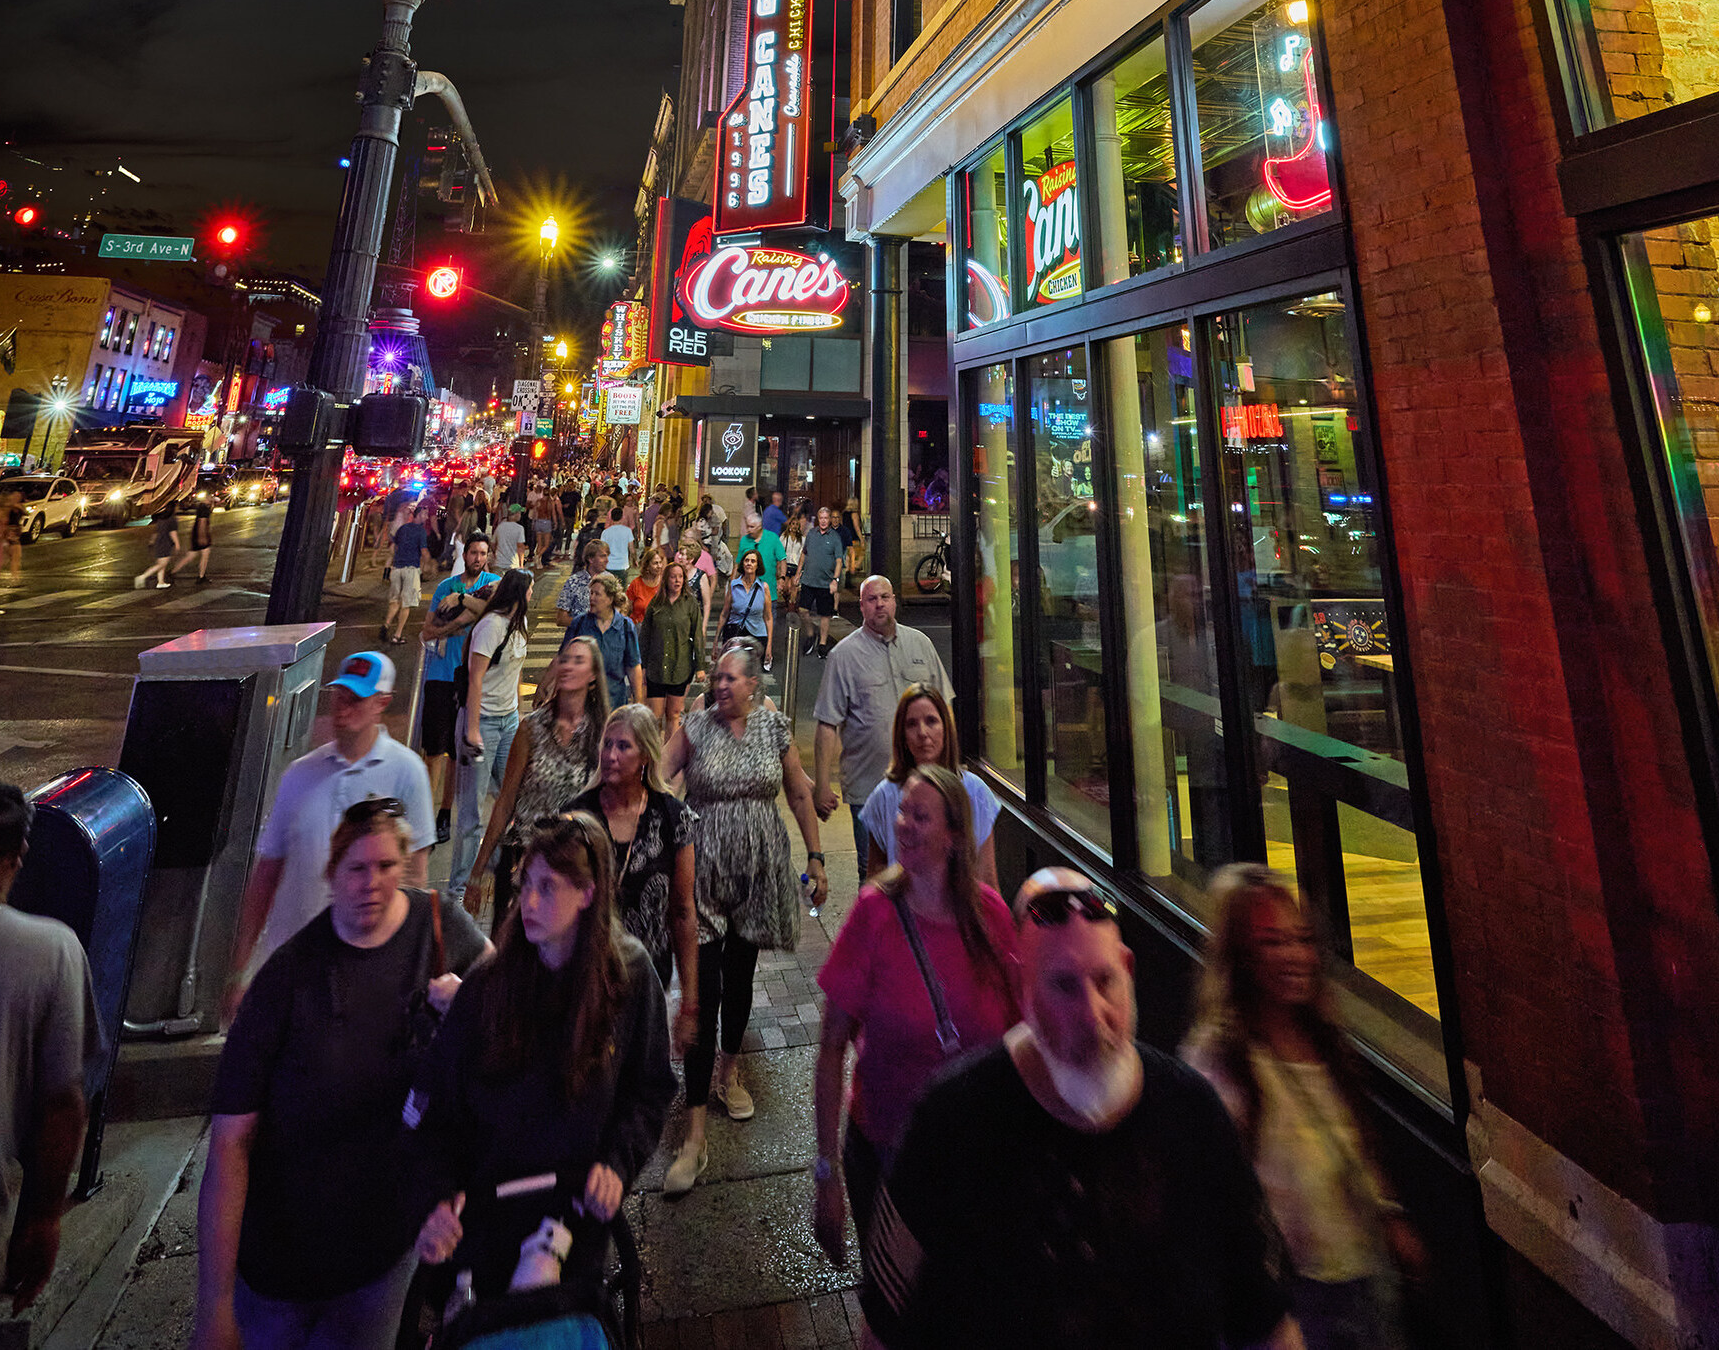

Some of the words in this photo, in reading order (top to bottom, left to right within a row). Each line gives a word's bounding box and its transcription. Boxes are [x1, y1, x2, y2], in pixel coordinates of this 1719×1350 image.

[747, 30, 776, 206] CANES
[728, 131, 744, 209] 1996
[750, 250, 804, 269] Raising
[692, 245, 847, 320] Cane's
[1047, 272, 1078, 295] CHICKEN
[612, 305, 628, 360] WHISKEY
[669, 326, 708, 343] OLE
[668, 341, 707, 356] RED
[512, 395, 523, 407] OK
[612, 392, 637, 400] BOOTS
[1048, 412, 1064, 420] THE
[1055, 419, 1080, 427] SHOW
[711, 465, 752, 477] LOOKOUT
